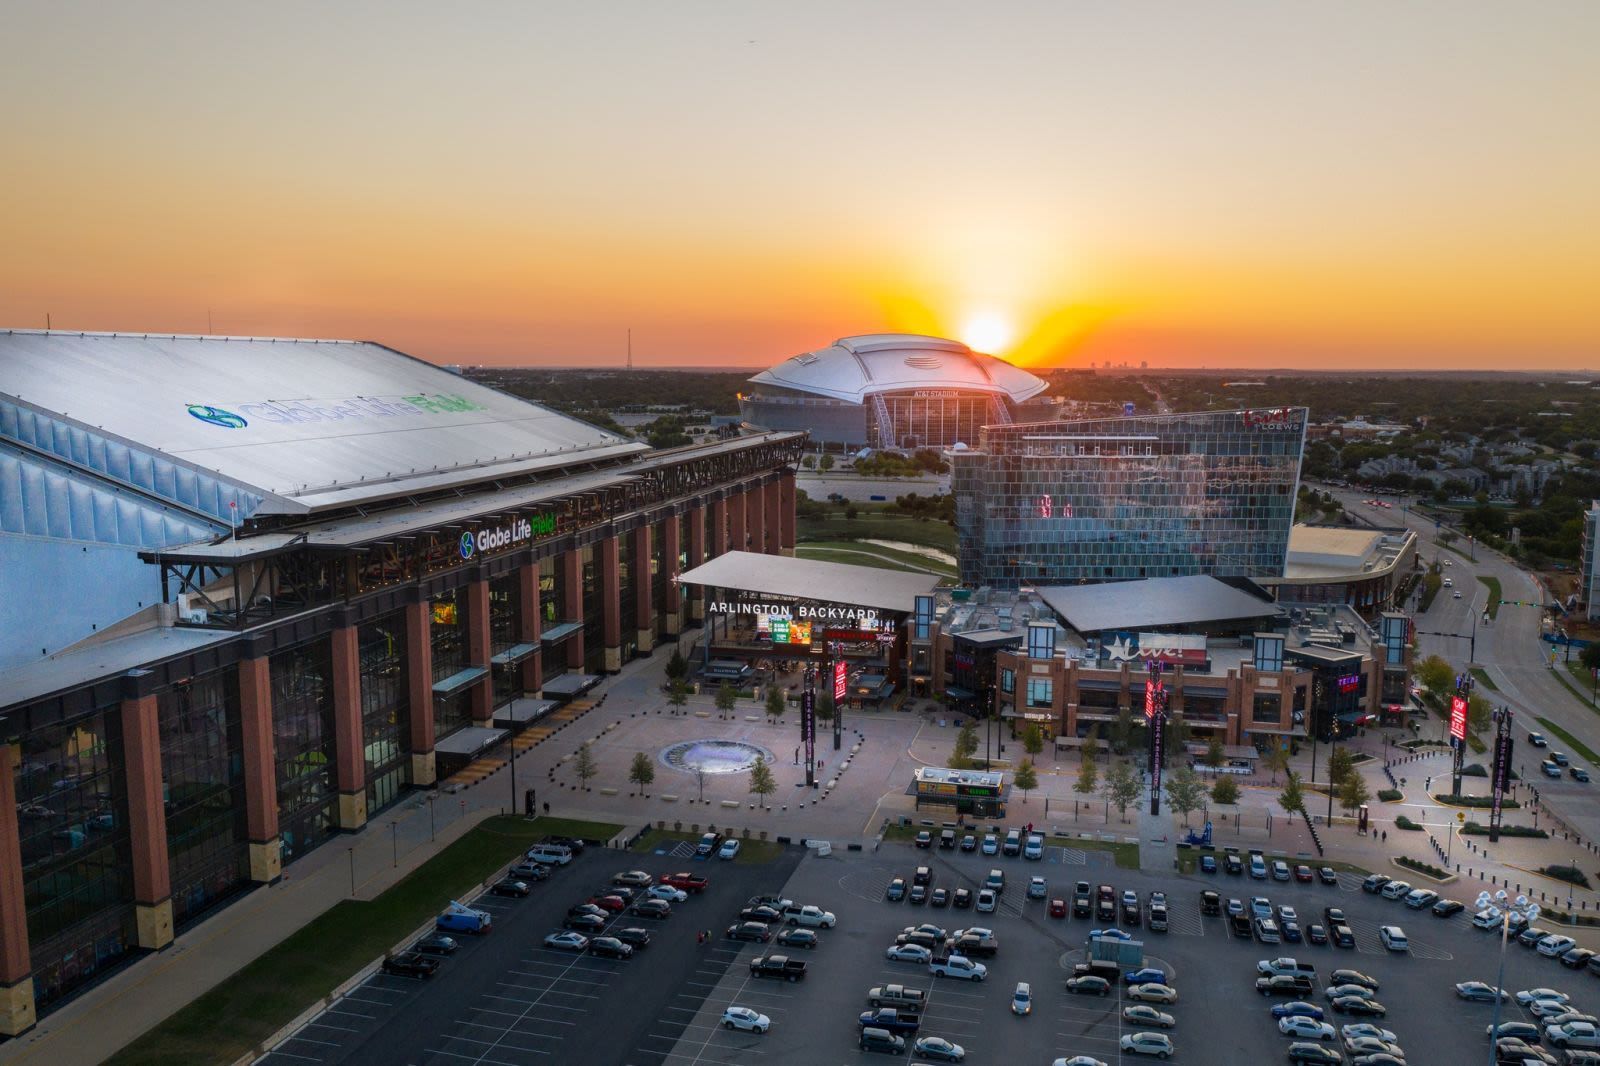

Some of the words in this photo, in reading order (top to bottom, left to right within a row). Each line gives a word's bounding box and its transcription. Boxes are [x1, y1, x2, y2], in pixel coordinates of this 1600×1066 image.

[1261, 423, 1300, 431] LOEWS
[477, 527, 511, 551] Globe
[512, 518, 531, 542] Life
[532, 512, 555, 537] Field
[709, 602, 790, 616] ARLINGTON
[799, 606, 877, 620] BACKYARD
[1117, 636, 1184, 662] Live!
